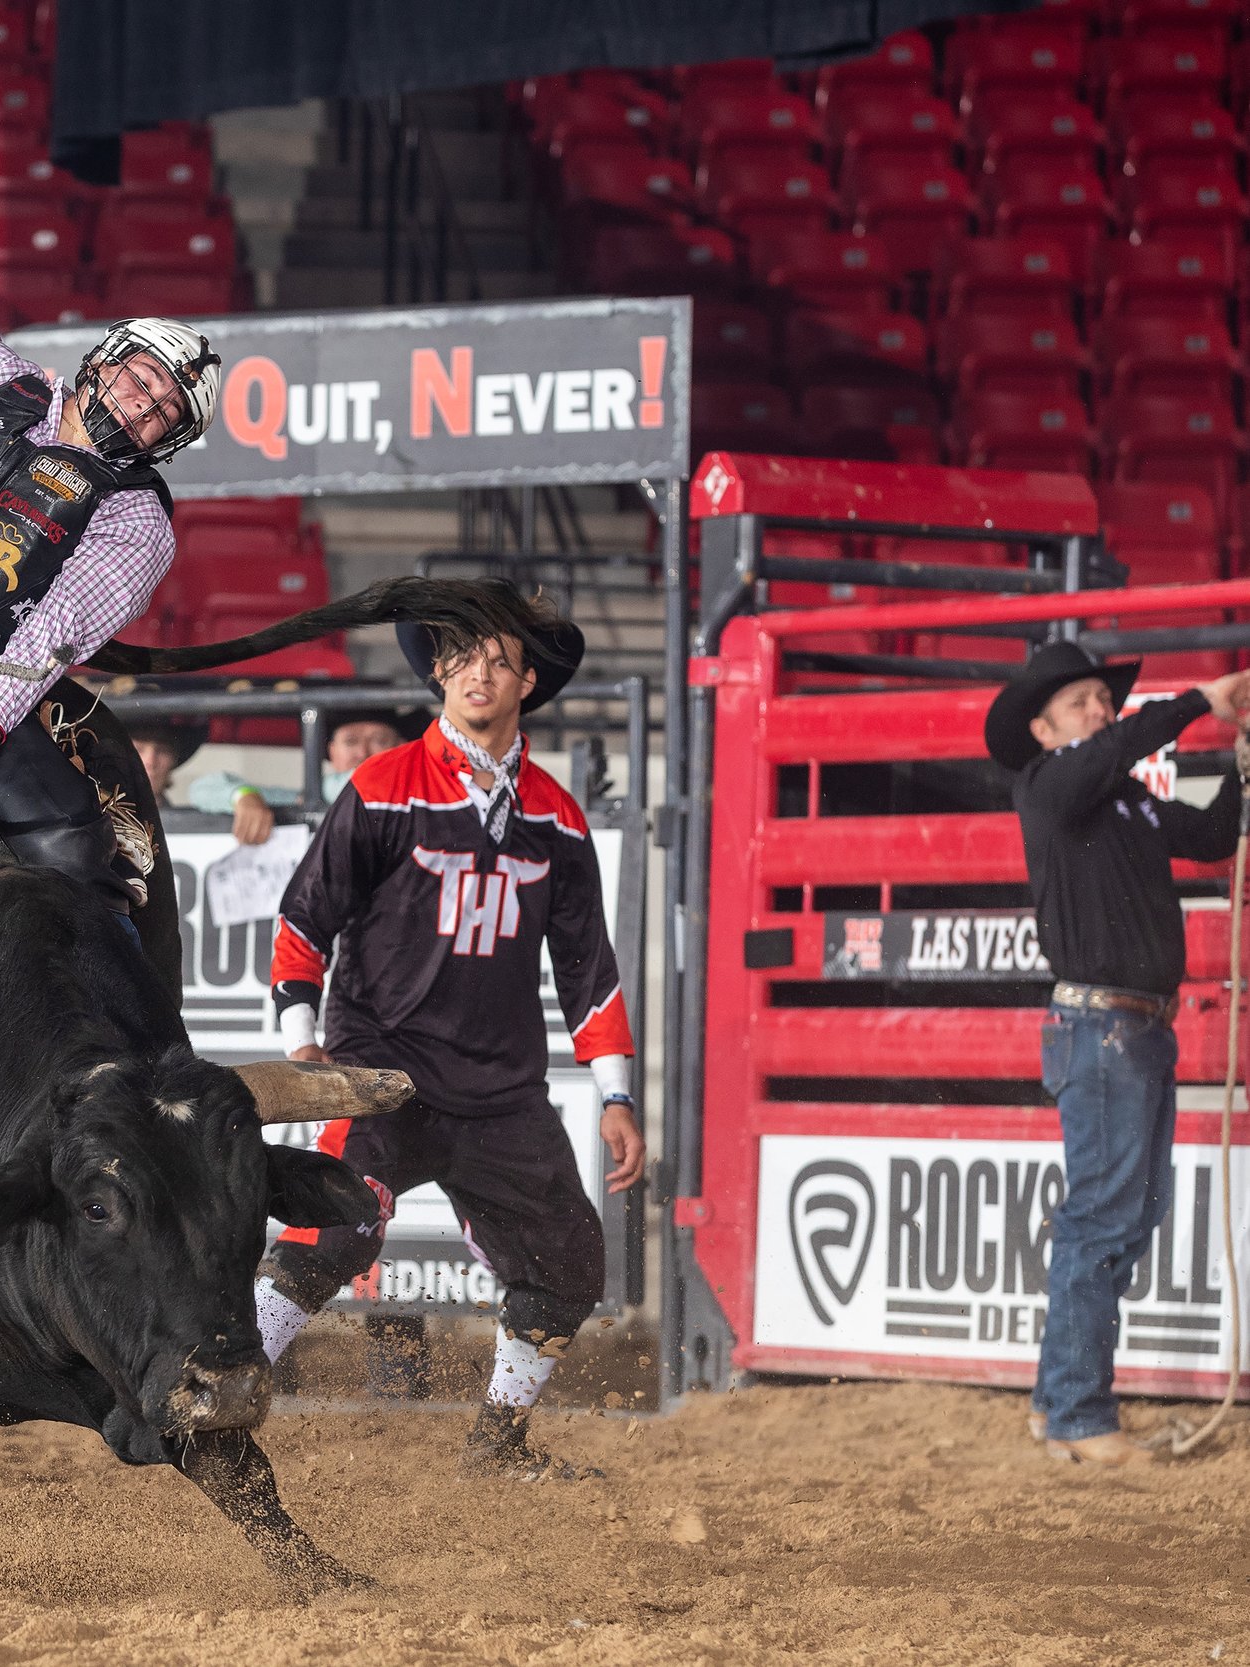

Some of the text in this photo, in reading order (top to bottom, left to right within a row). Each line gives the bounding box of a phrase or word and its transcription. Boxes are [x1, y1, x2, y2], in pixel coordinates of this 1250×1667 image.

[222, 335, 668, 462] QUIT, NEVER!
[36, 458, 60, 478] CHAD
[907, 916, 972, 971] LAS
[973, 916, 1050, 971] VEG
